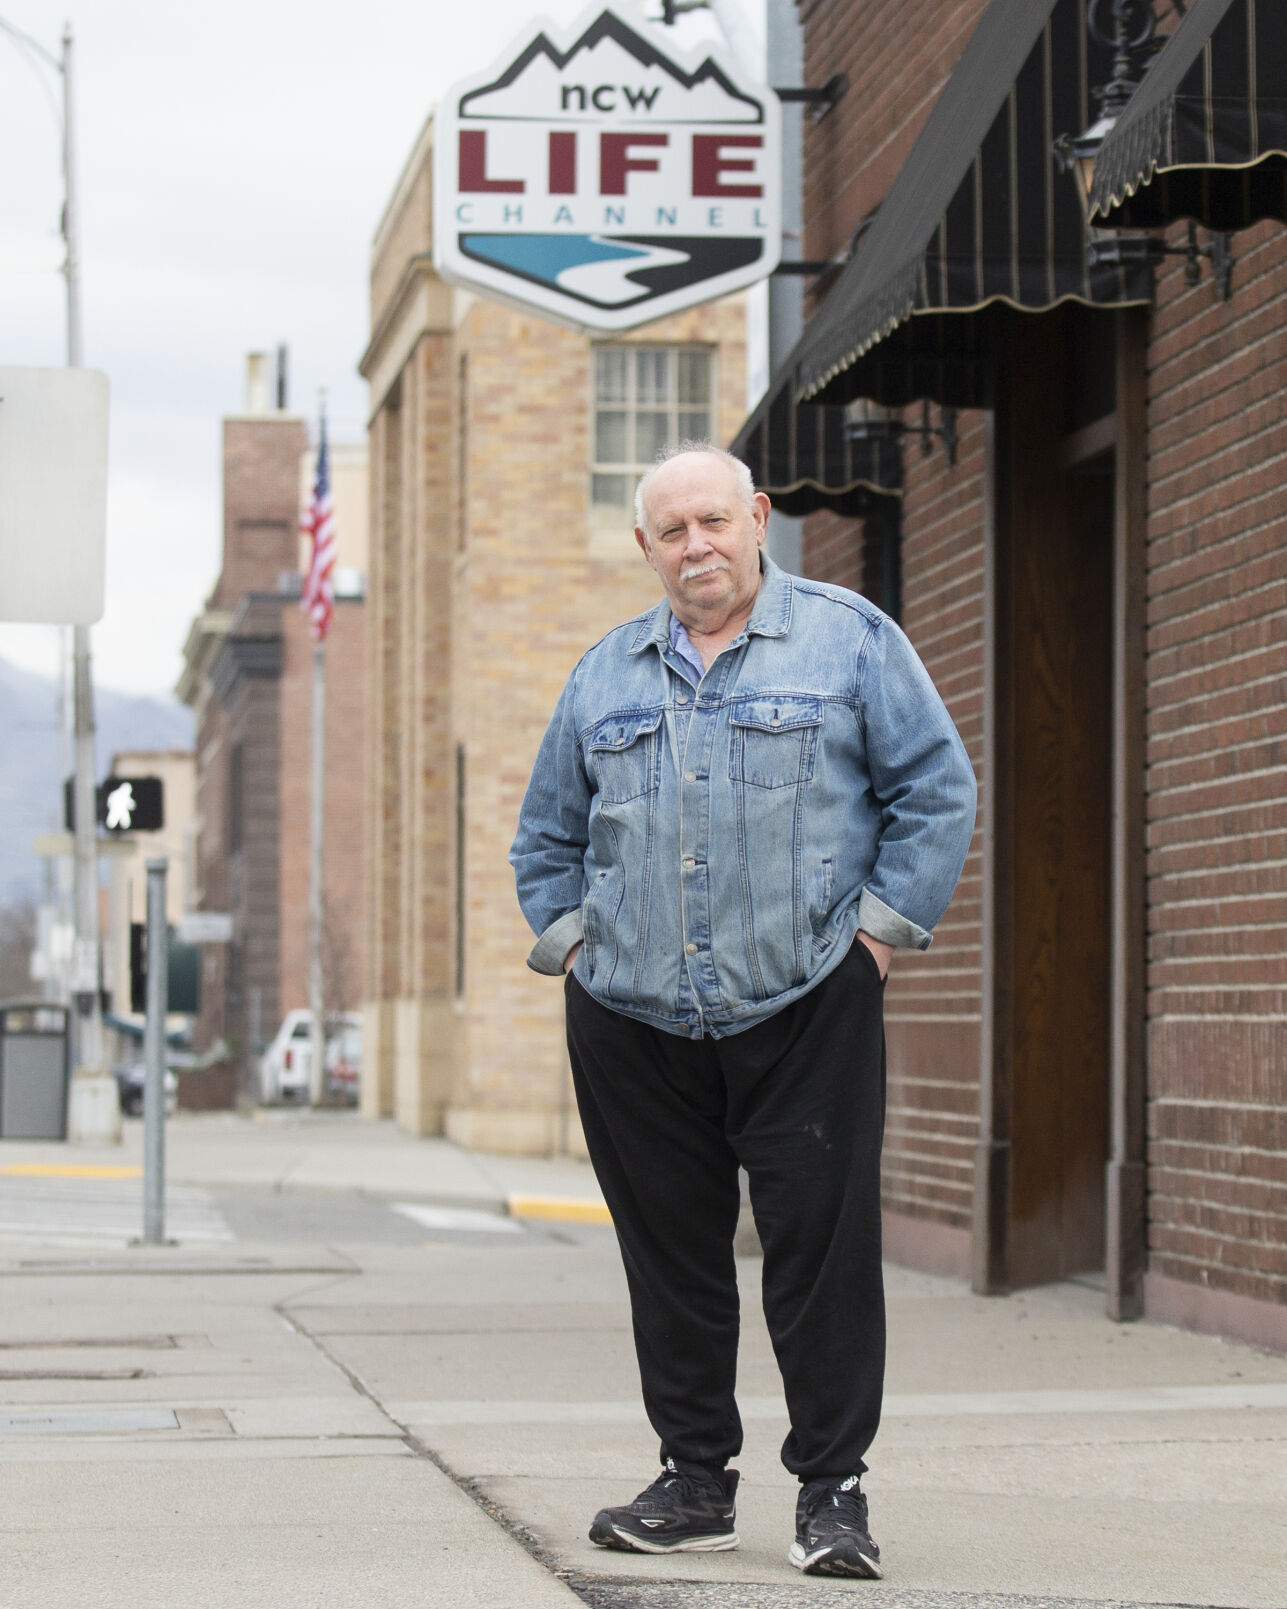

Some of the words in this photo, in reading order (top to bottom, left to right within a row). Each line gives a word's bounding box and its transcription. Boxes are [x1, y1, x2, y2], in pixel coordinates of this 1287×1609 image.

[561, 84, 661, 112] ncw
[458, 130, 765, 198] LIFE
[455, 203, 767, 229] CHANNEL
